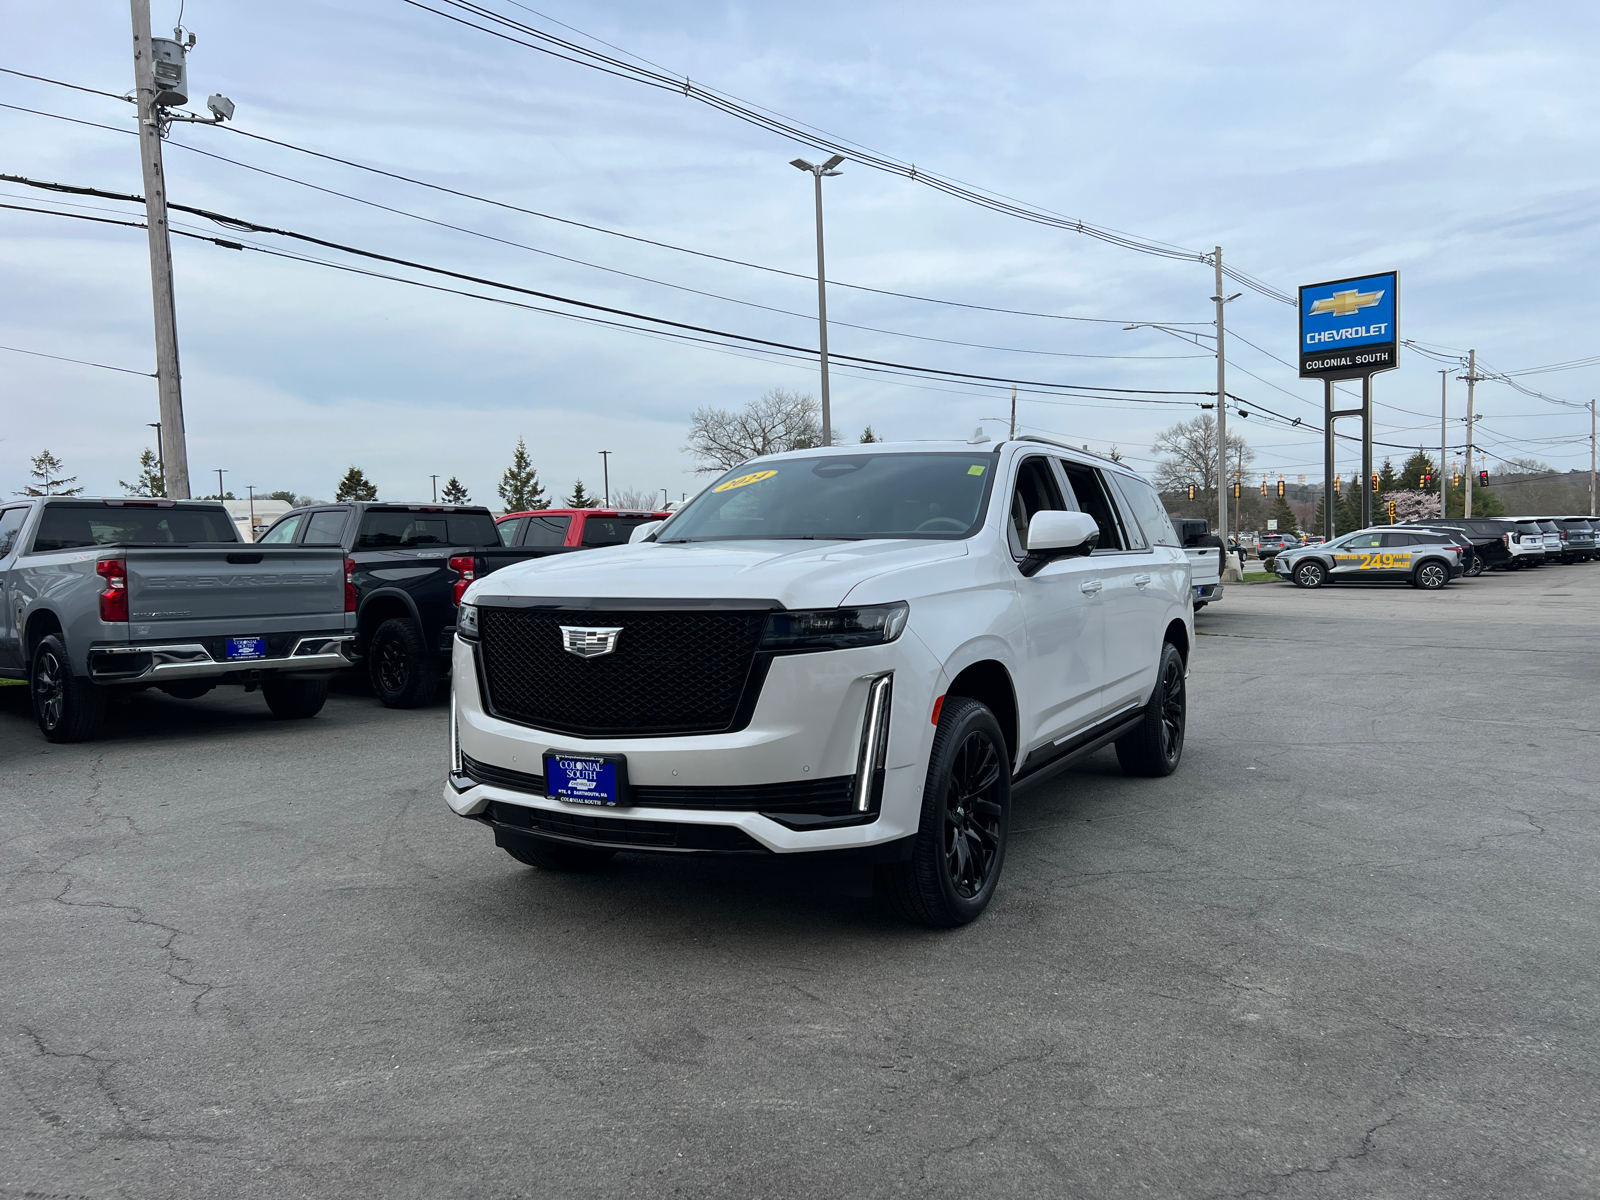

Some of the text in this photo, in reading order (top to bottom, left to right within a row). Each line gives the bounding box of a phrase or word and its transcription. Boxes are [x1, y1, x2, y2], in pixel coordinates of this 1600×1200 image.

[1306, 323, 1388, 344] CHEVROLET
[1306, 352, 1389, 370] COLONIAL SOUTH
[720, 471, 771, 491] 2024
[143, 573, 333, 588] CHEVROLET
[560, 760, 603, 771] COLONIAL
[566, 770, 597, 779] SOUTH
